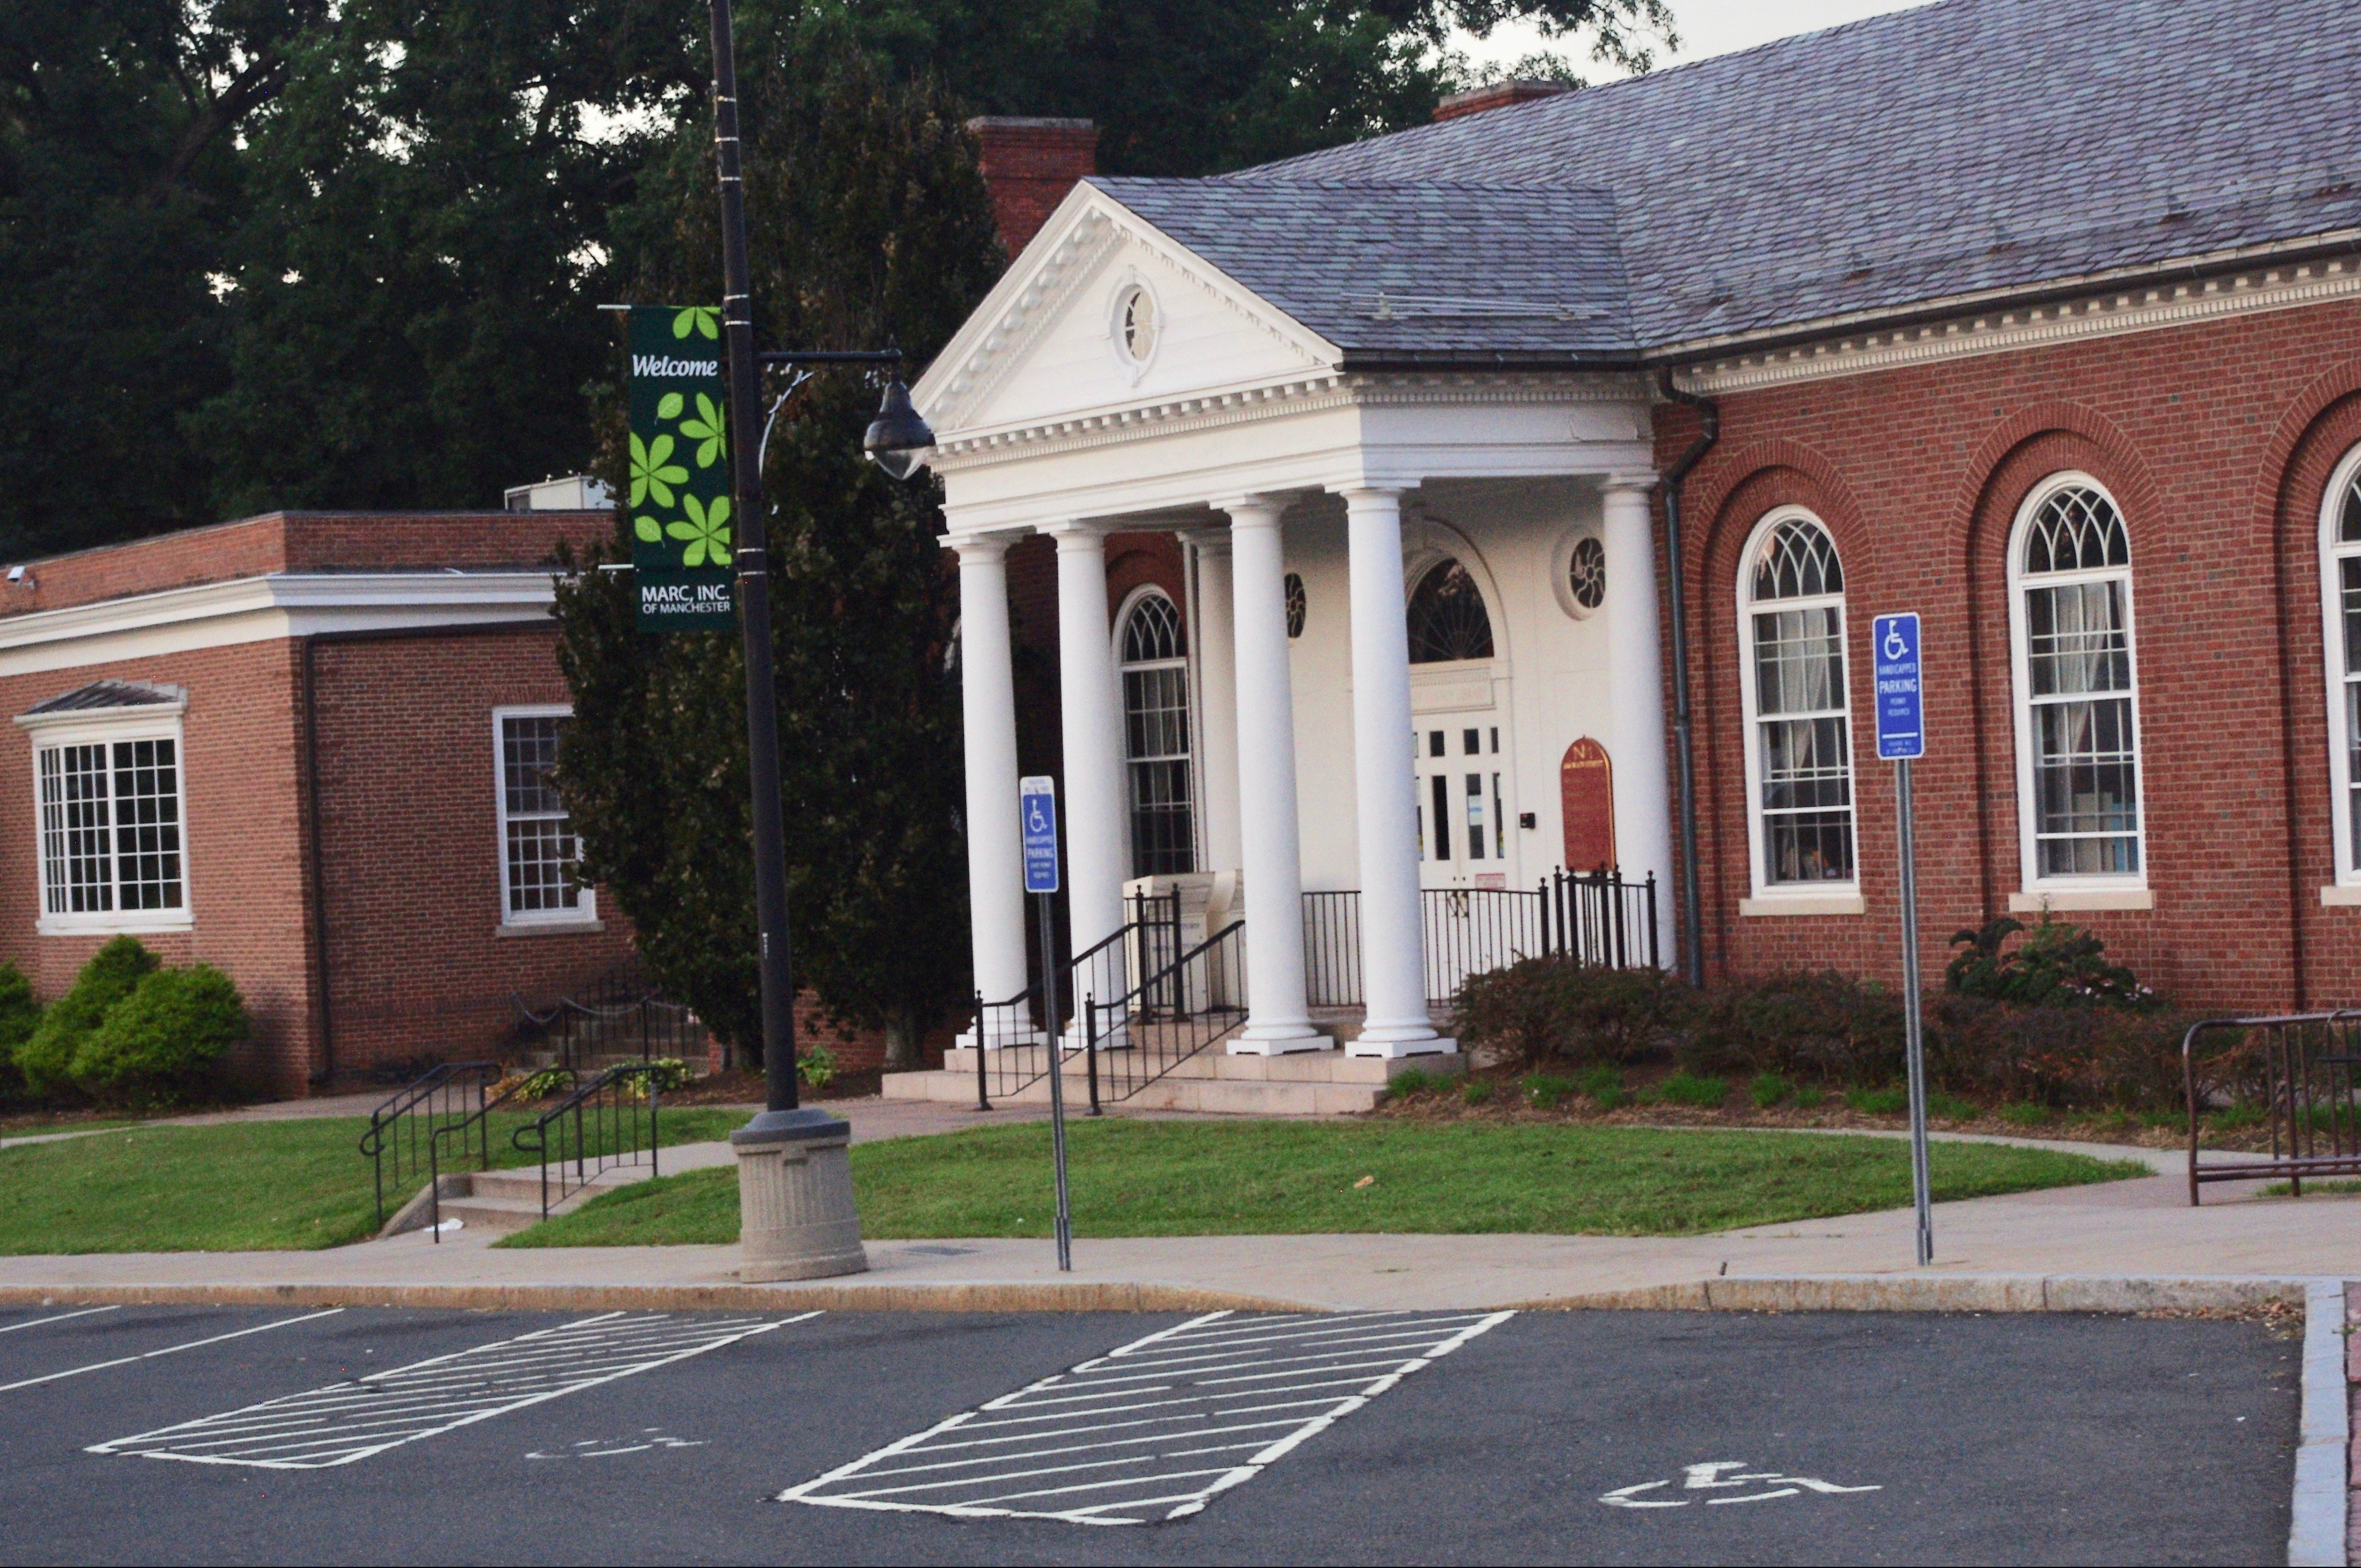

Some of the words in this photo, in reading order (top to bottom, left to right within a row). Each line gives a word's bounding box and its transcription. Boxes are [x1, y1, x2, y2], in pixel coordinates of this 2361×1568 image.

[632, 354, 718, 377] Welcome
[642, 585, 694, 604] MARC,
[697, 584, 730, 601] INC.
[642, 603, 657, 615] OF
[660, 601, 730, 614] MANCHESTER
[1878, 662, 1916, 675] HANDICAPPED
[1879, 678, 1917, 694] PARKING
[1027, 848, 1054, 859] PARKING
